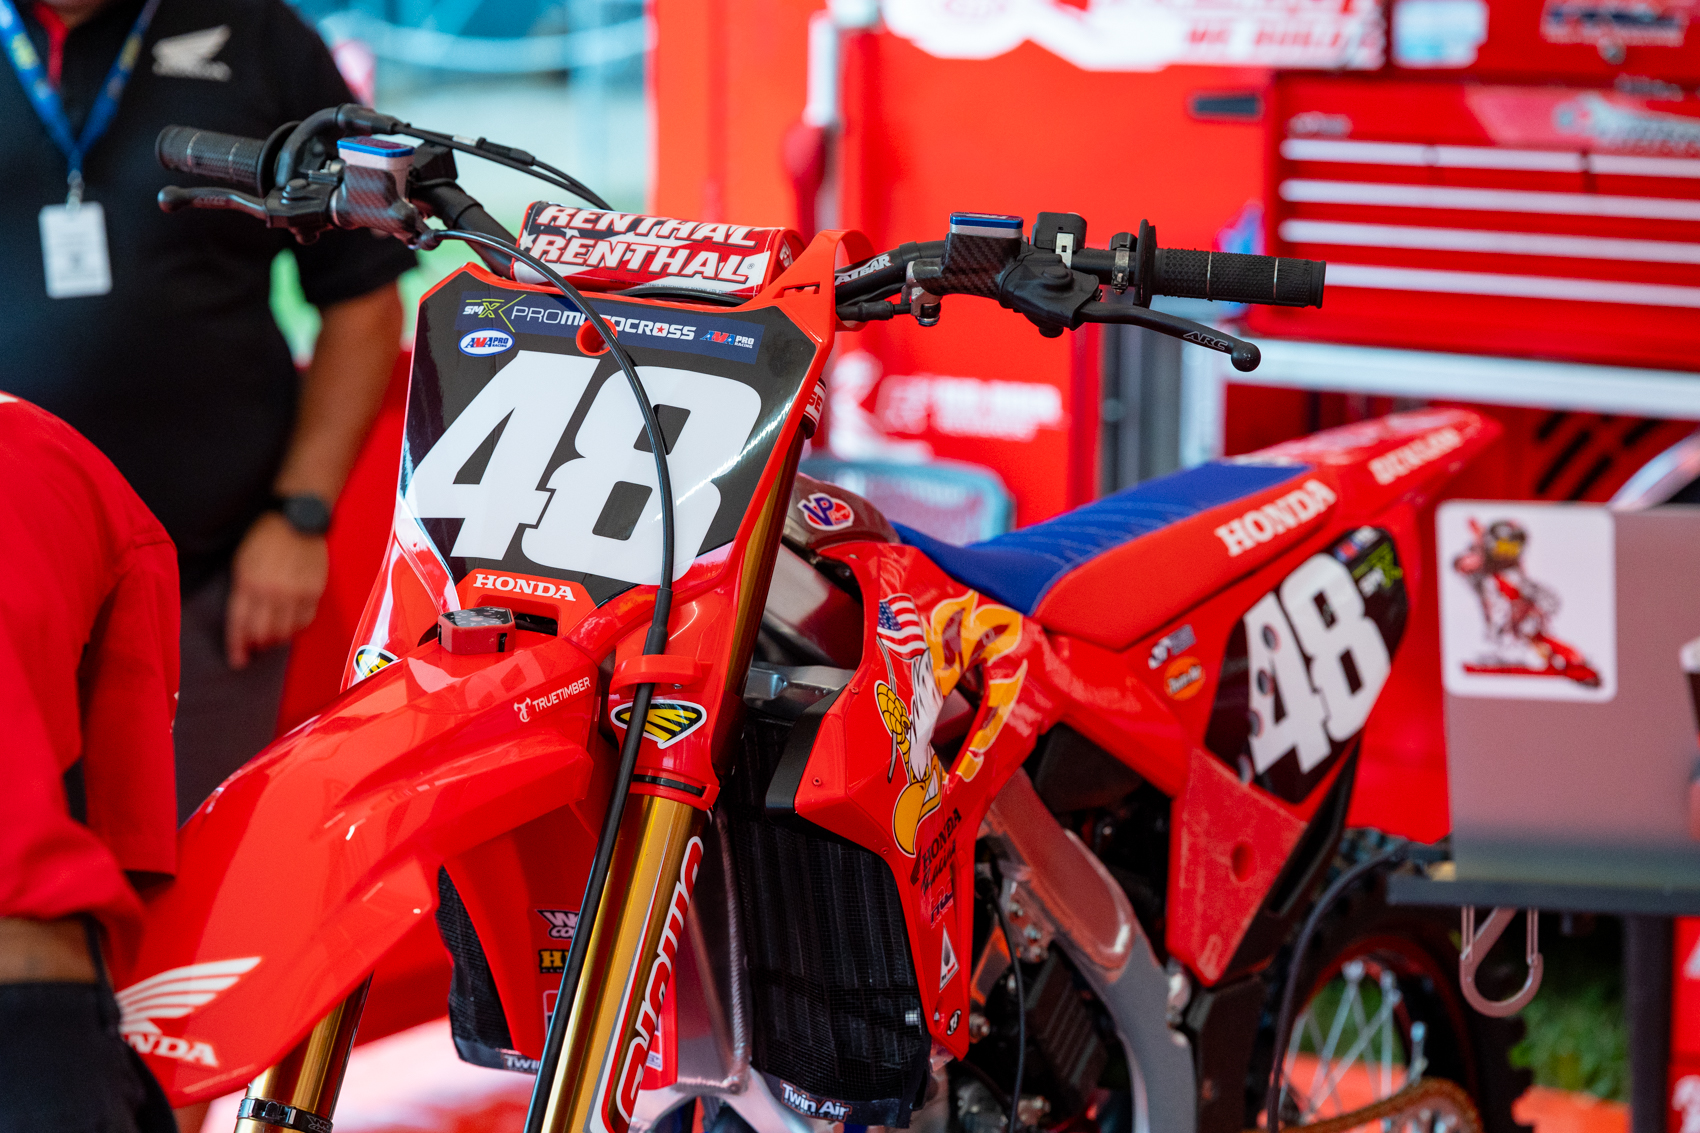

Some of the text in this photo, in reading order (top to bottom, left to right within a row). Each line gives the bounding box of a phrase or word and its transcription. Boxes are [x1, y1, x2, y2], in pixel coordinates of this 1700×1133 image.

[535, 206, 758, 248] RENTHAL
[537, 234, 752, 283] RENTHAL
[835, 253, 892, 287] ATBAR
[511, 305, 697, 341] PROMOCROSS
[700, 330, 755, 345] AMA PRO
[1183, 330, 1229, 351] ARC
[464, 336, 509, 348] AMA PRO
[400, 350, 762, 586] 48
[802, 496, 834, 527] VP
[1214, 478, 1338, 558] HONDA
[473, 573, 577, 602] HONDA
[1243, 552, 1392, 775] 48
[532, 676, 591, 712] TRUETIMBER
[922, 807, 962, 874] HONDA
[125, 1033, 220, 1067] NDA
[782, 1083, 849, 1116] Twin Air
